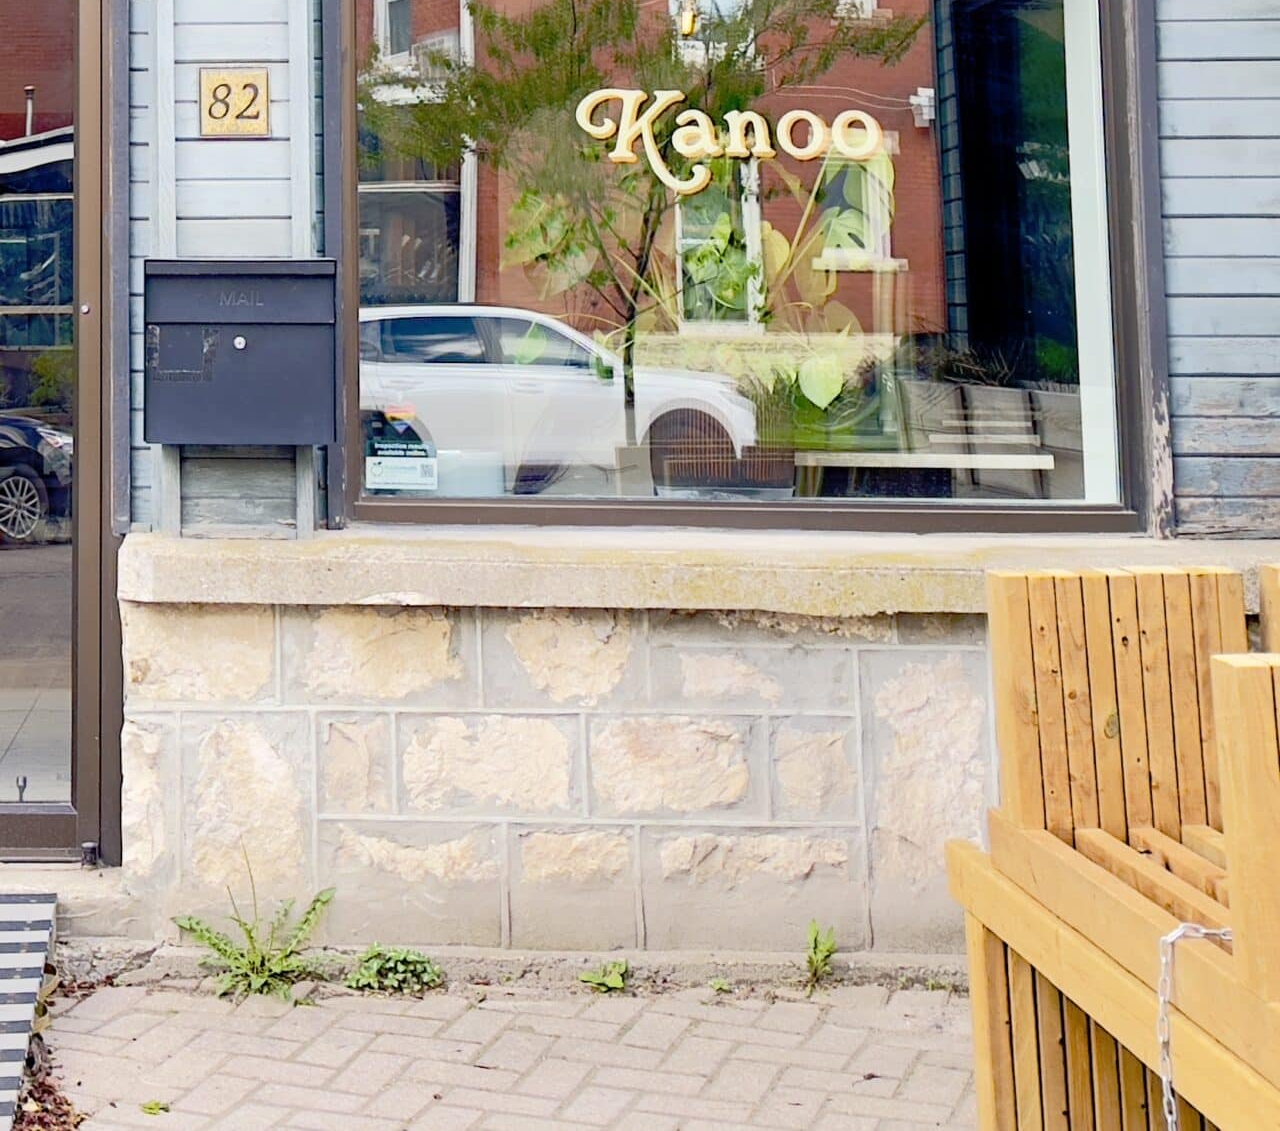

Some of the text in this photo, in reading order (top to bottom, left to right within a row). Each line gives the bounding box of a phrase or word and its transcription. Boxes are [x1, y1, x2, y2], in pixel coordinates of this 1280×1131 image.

[208, 83, 260, 120] 82
[575, 88, 885, 195] Kanoo
[219, 291, 265, 306] MAIL
